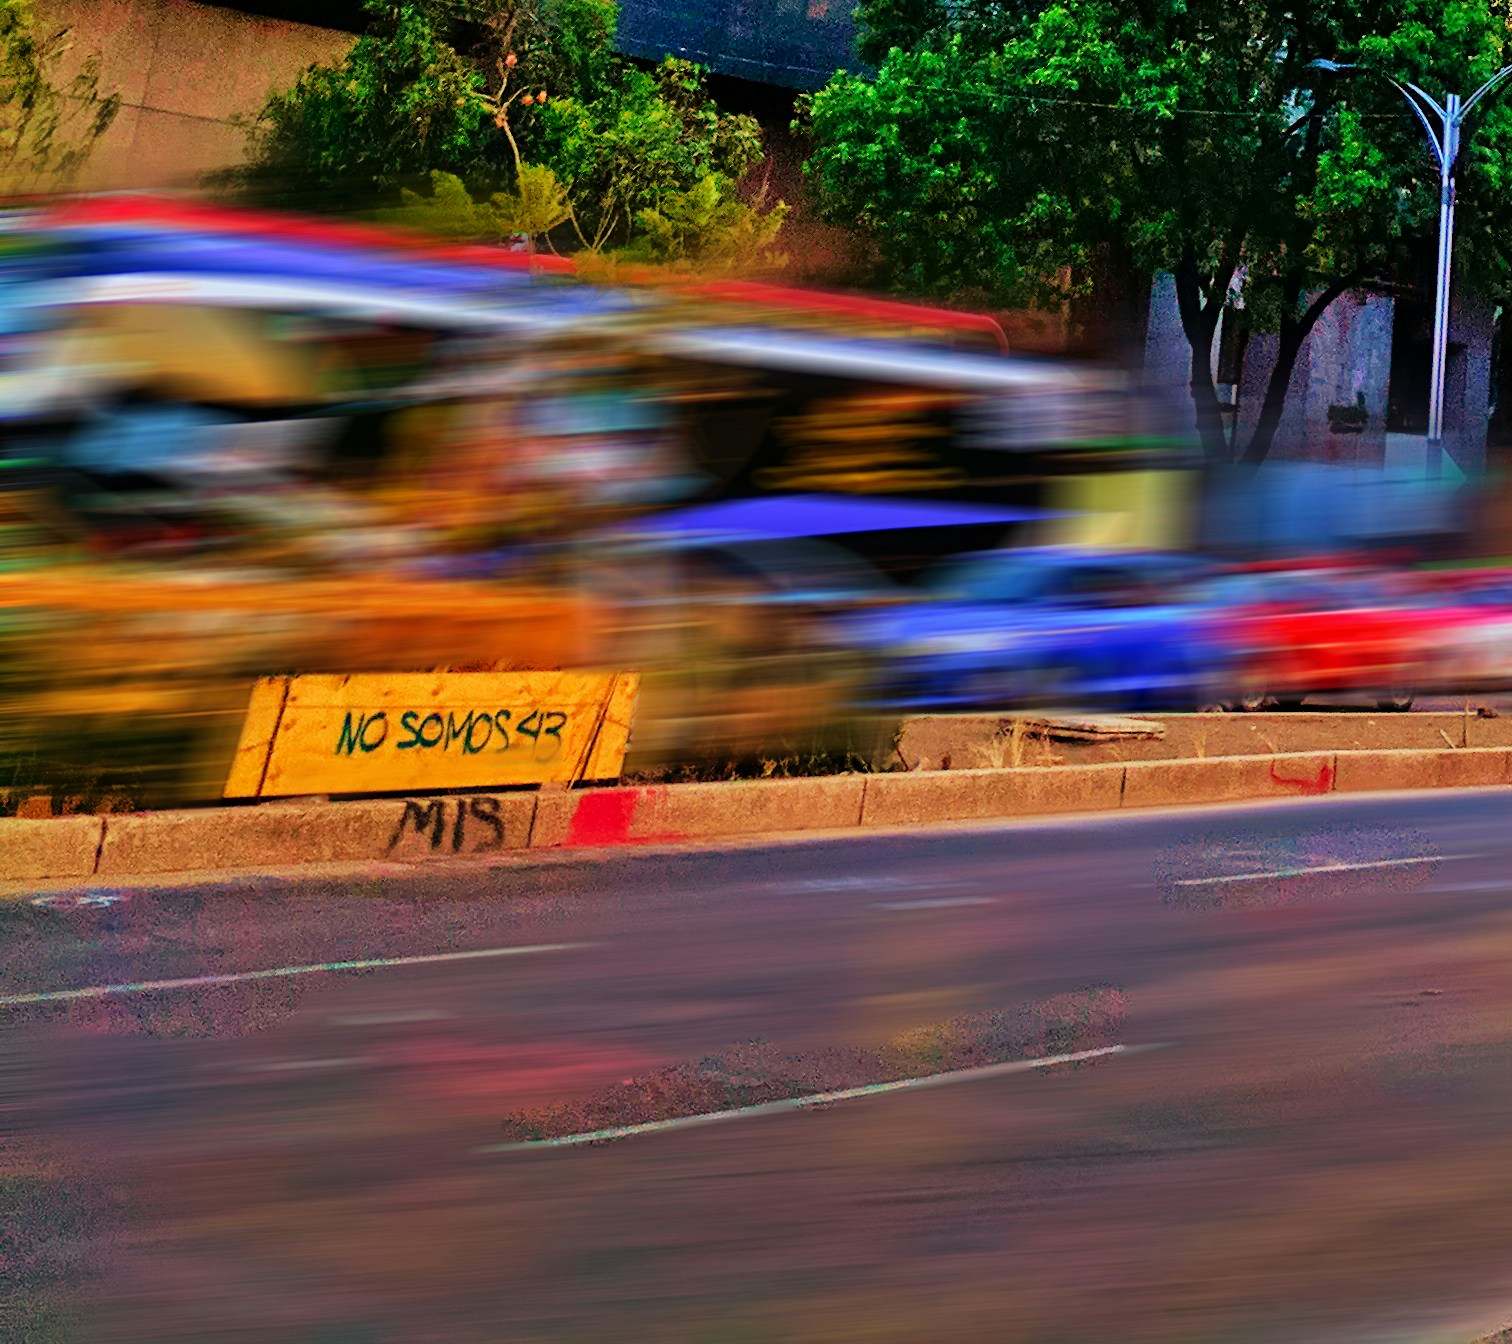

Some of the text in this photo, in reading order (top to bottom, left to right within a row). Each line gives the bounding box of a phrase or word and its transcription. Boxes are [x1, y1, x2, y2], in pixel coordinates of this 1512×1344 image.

[335, 708, 568, 763] NO SOMOS 43
